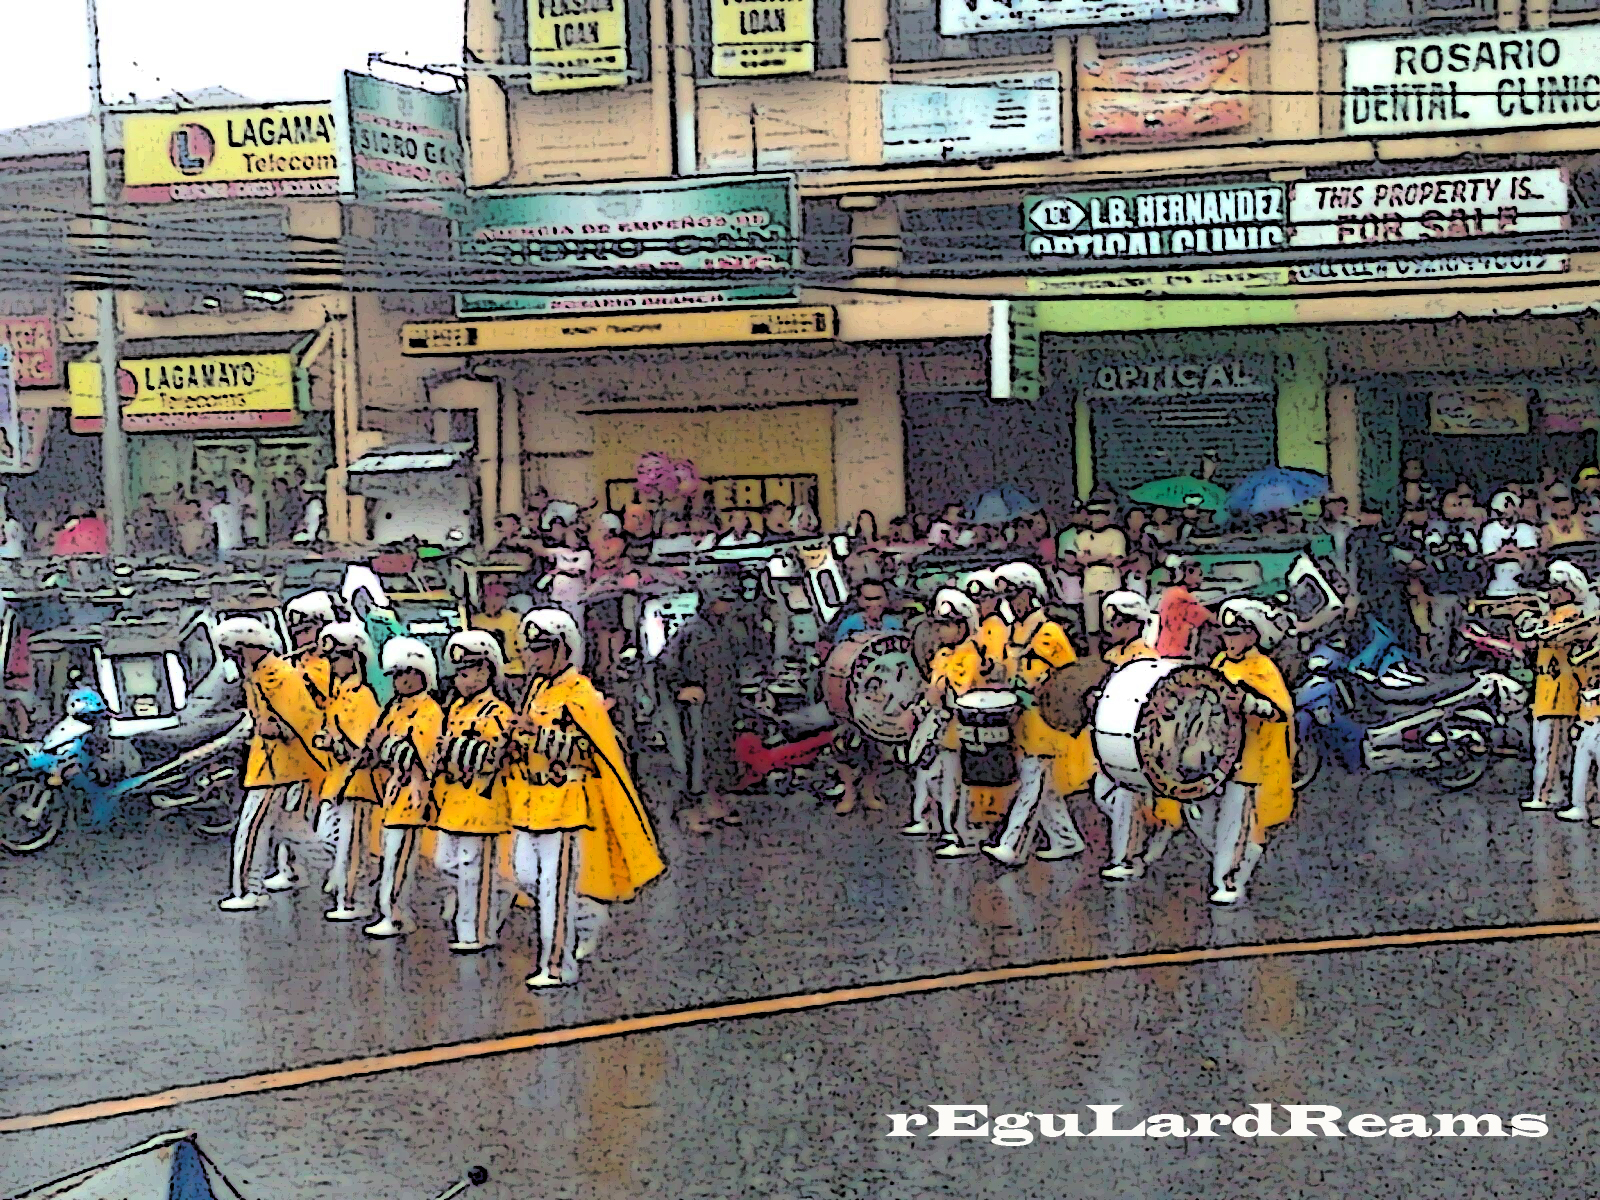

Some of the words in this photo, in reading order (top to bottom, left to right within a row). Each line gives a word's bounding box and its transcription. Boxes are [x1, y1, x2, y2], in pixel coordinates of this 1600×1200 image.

[1395, 38, 1560, 75] ROSARIO
[1352, 80, 1470, 124] DENTAL
[1498, 74, 1600, 117] CLINIC
[1136, 188, 1284, 228] HERNANDEZ
[1315, 186, 1363, 210] THIS
[1374, 178, 1500, 207] PROPERTY
[1029, 230, 1163, 257] OPTICAL
[1171, 225, 1285, 254] CLINIC
[1337, 212, 1404, 243] FOR
[1419, 206, 1519, 238] SALE
[145, 361, 255, 391] LAGAMAYO
[1096, 362, 1252, 392] OPTICAL
